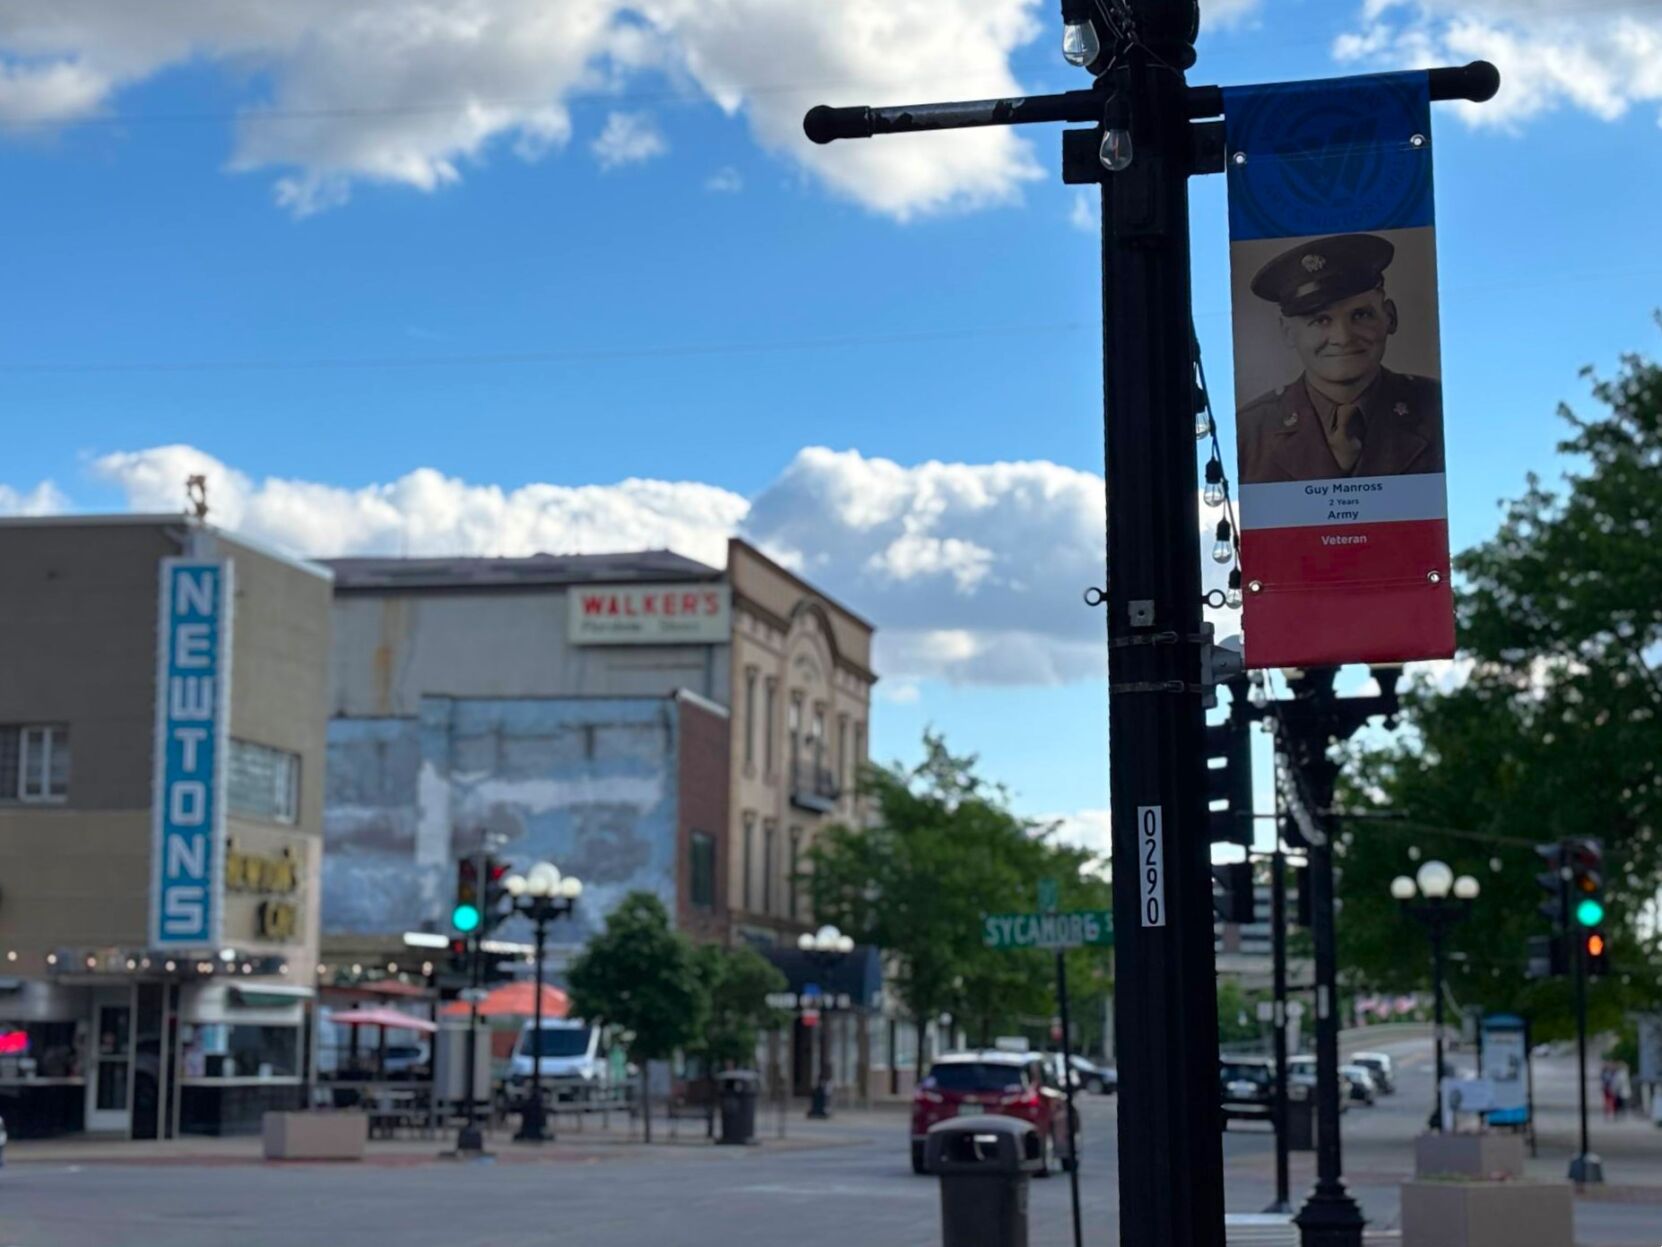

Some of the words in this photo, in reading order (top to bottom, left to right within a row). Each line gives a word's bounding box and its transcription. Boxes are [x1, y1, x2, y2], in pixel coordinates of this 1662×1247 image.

[1304, 485, 1329, 496] Guy
[1332, 481, 1383, 493] Manross
[1336, 498, 1359, 506] Years
[1327, 510, 1359, 521] Army
[1321, 534, 1367, 546] Veteran
[164, 571, 214, 936] NEWTONS
[1143, 809, 1159, 925] 0290
